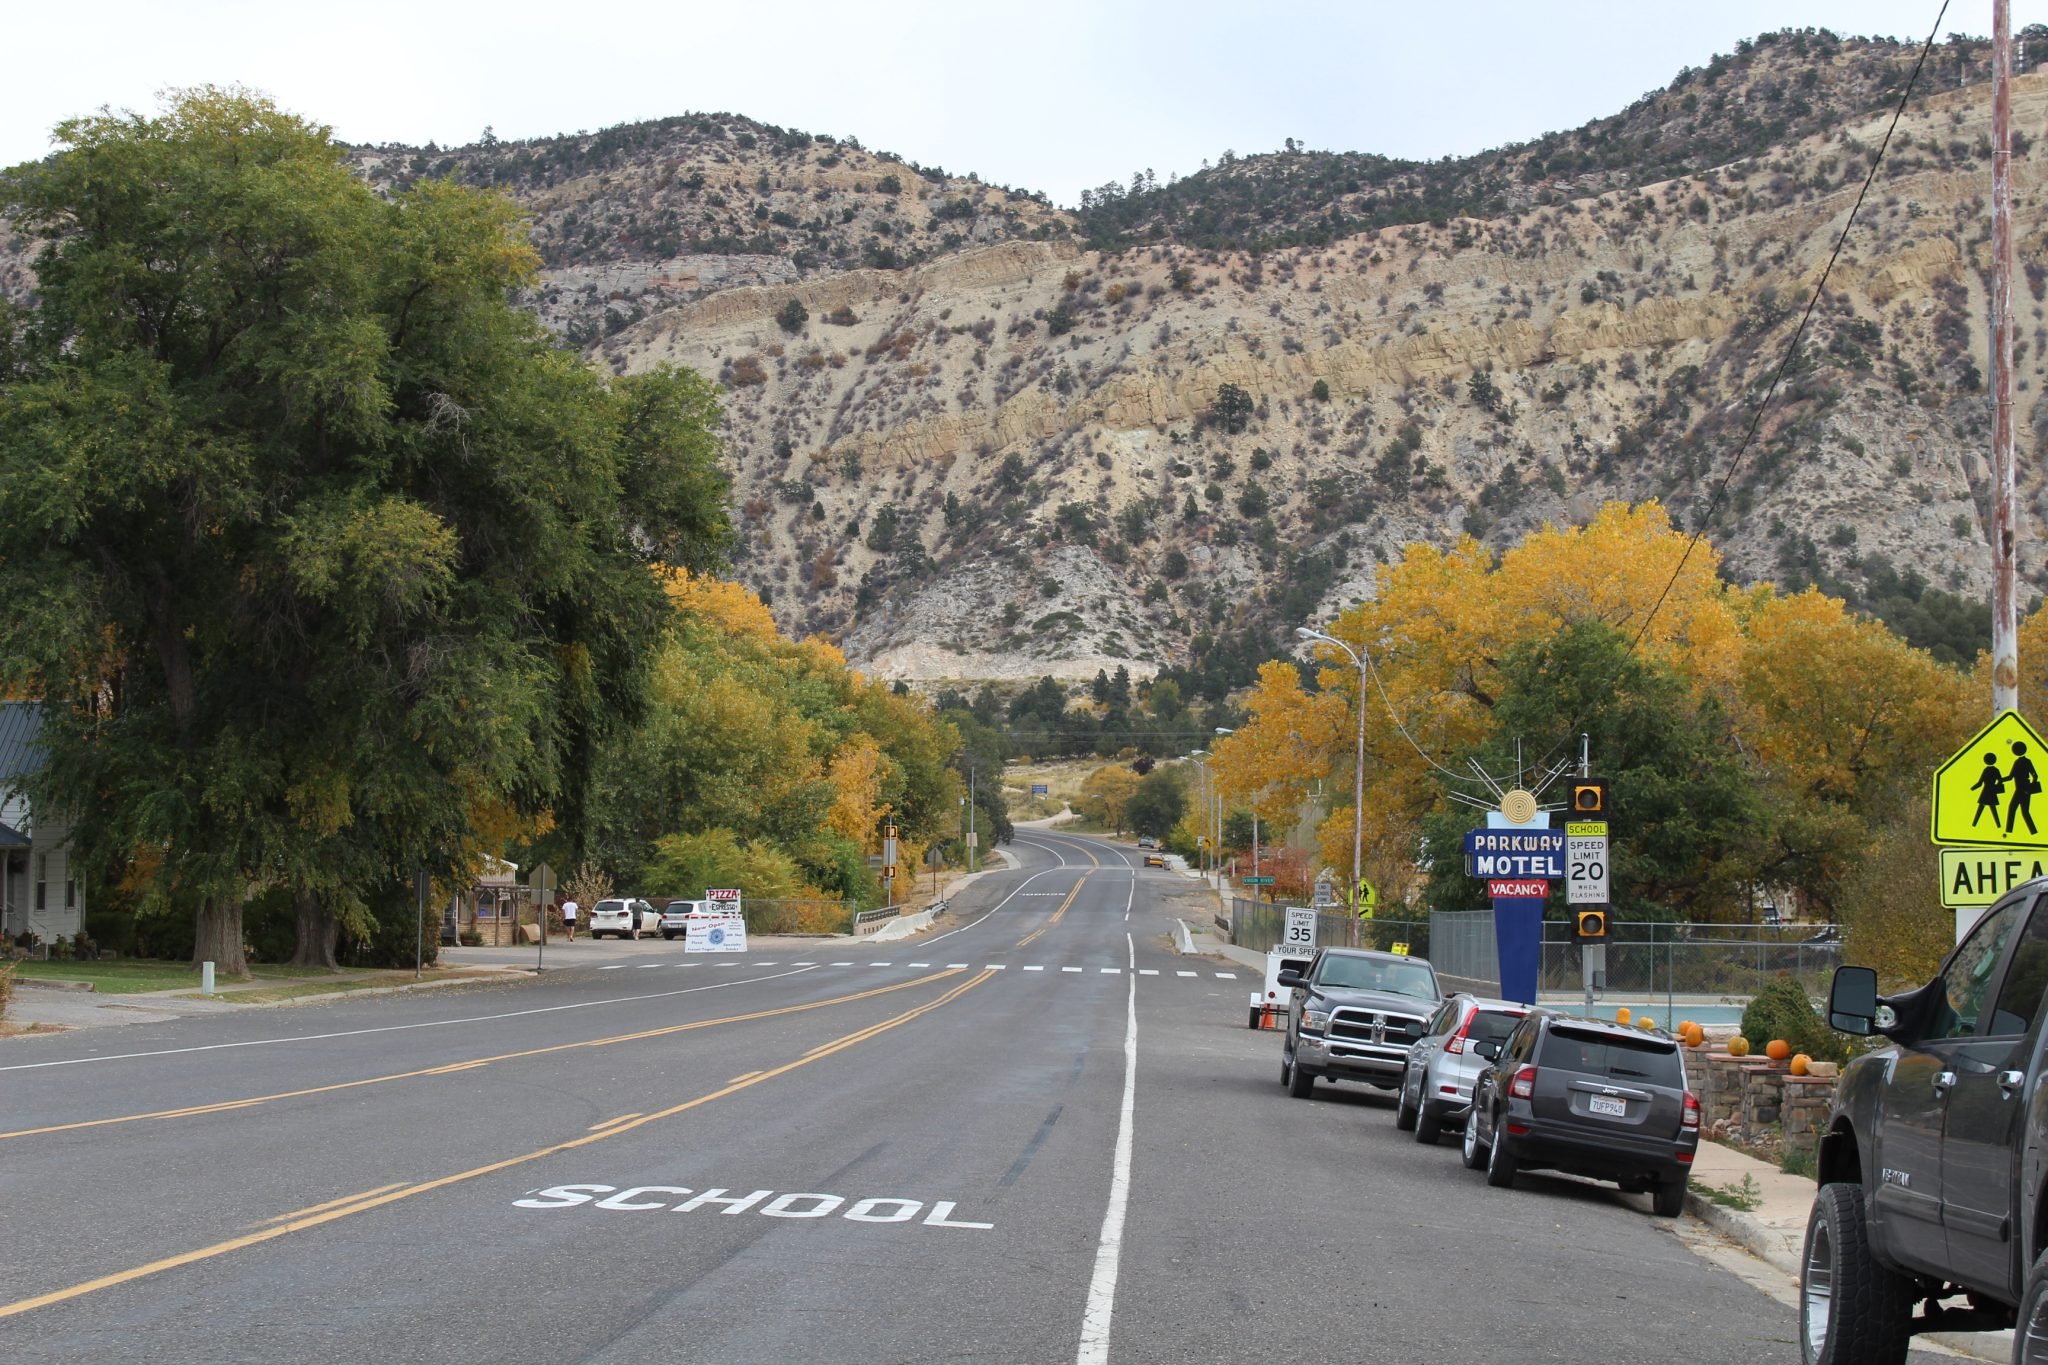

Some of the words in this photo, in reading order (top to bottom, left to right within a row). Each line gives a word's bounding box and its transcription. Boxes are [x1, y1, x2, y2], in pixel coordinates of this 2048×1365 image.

[1568, 825, 1605, 834] SCHOOL
[1475, 835, 1562, 851] PARKWAY
[1570, 841, 1604, 850] SPEED
[1573, 851, 1601, 860] LIMIT
[1477, 855, 1562, 875] MOTEL
[1571, 862, 1604, 881] 20
[1490, 883, 1545, 895] VACANCY
[709, 890, 737, 899] PIZZA
[711, 903, 736, 911] ESPRESSO
[1291, 911, 1314, 920] SPEED
[1289, 927, 1311, 942] 35
[1277, 946, 1297, 954] YOUR
[1592, 1100, 1623, 1114] 7UFP940
[511, 1183, 995, 1230] SCHOOL
